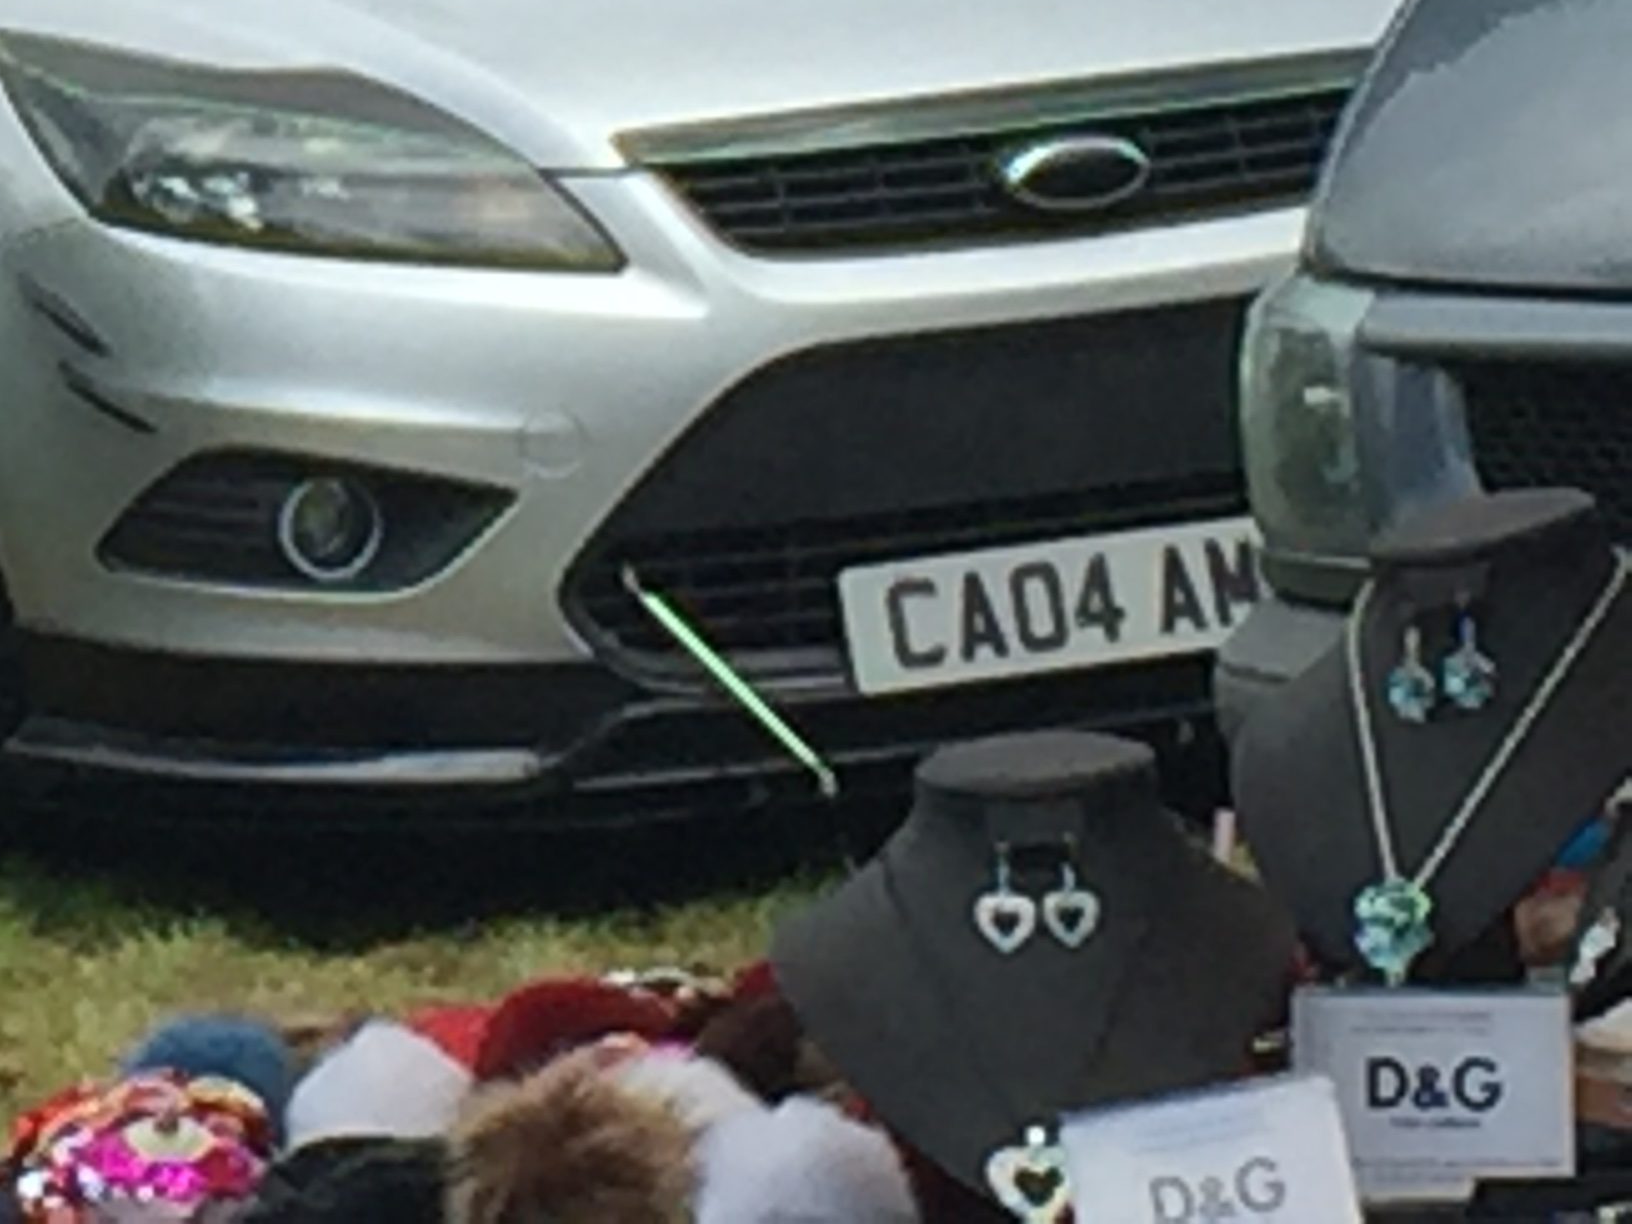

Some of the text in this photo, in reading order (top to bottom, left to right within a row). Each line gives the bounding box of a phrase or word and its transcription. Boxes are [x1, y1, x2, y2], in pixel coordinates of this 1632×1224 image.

[885, 553, 1126, 669] CA04
[1366, 1056, 1503, 1111] D&G
[1149, 1155, 1287, 1224] D&G
